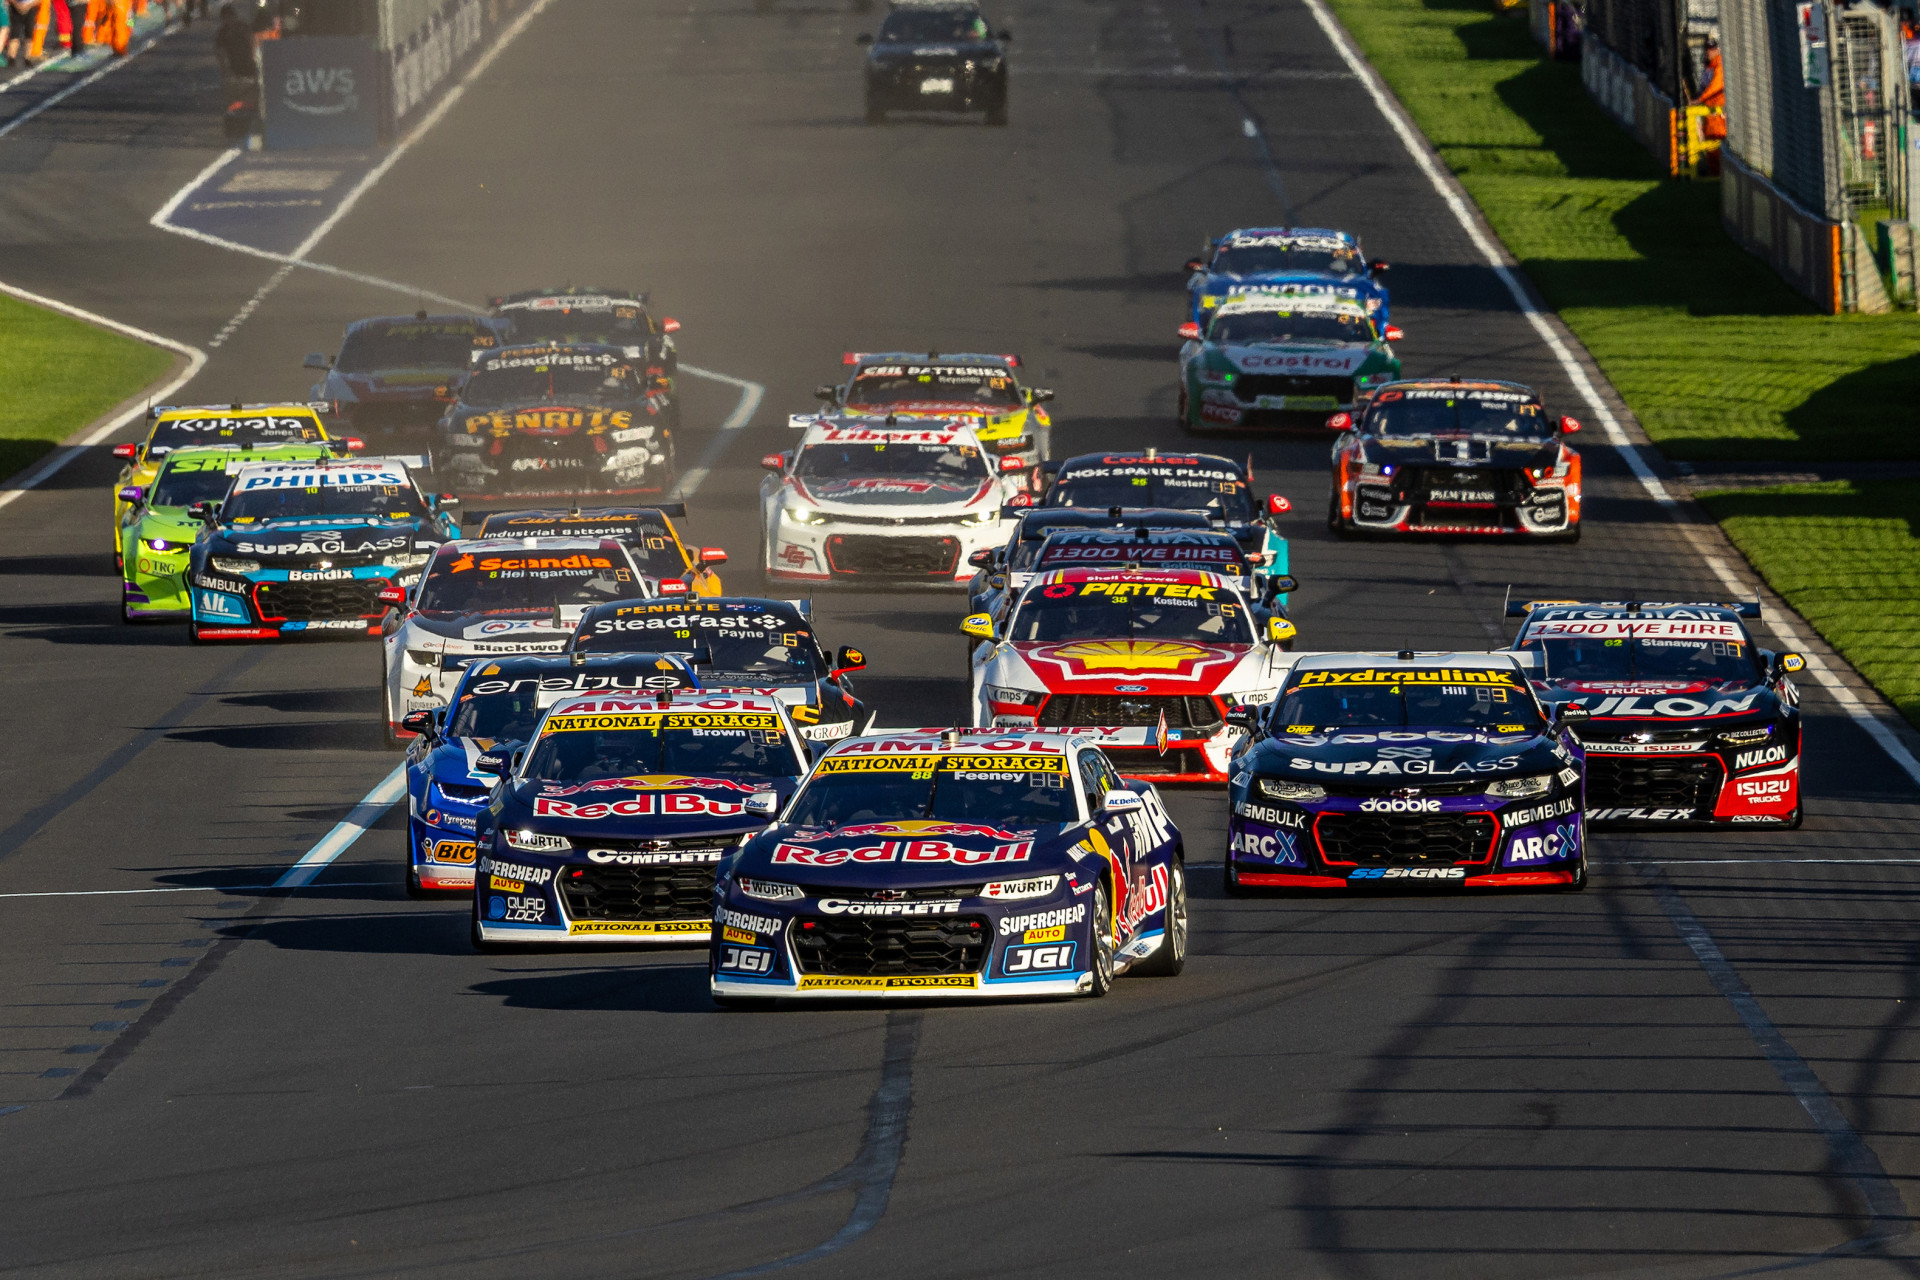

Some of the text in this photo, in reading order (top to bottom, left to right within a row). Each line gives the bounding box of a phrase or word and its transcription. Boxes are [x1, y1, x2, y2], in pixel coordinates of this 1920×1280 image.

[286, 67, 354, 95] aws
[1231, 236, 1344, 249] DAYCO
[487, 354, 593, 371] Steadfast
[1241, 355, 1351, 370] Castrol
[907, 366, 1007, 377] BATTERIES
[171, 416, 303, 433] Kubota
[466, 411, 633, 434] PENRITE
[825, 429, 955, 445] Liberty
[1102, 456, 1199, 465] Coates
[245, 472, 402, 490] PHILIPS
[1066, 467, 1237, 481] NGK SPARK PLUGS
[305, 487, 318, 495] 10
[562, 527, 633, 536] Batteries
[237, 536, 406, 555] SUPAGLASS
[1048, 548, 1233, 560] 1300 WE HIRE
[152, 560, 176, 575] TRG
[479, 555, 612, 571] Scandia
[289, 569, 354, 581] Bendix
[489, 570, 498, 579] 8
[500, 567, 594, 579] Heimgartner
[1086, 574, 1180, 583] Shell V-Power
[194, 573, 247, 595] MGMBULK
[1079, 582, 1219, 601] PIRTEK
[201, 593, 229, 613] Alt.
[1111, 596, 1128, 604] 38
[1153, 596, 1198, 608] Kostecki
[616, 603, 721, 616] PENRITE
[1542, 609, 1723, 621] PremiAir
[594, 613, 751, 635] Steadfast
[1530, 623, 1735, 637] 1300 WE HIRE
[674, 629, 690, 639] 19
[718, 628, 765, 640] Payne
[1604, 638, 1623, 648] 62
[1641, 638, 1709, 650] Stanaway
[1786, 656, 1801, 669] NAPA
[472, 673, 681, 696] erebus
[1299, 669, 1514, 685] Hydraulink
[999, 690, 1022, 702] mps
[1248, 691, 1268, 702] mps
[1389, 685, 1401, 695] 4
[1441, 686, 1468, 696] Hill
[557, 699, 772, 714] AMPOL
[1554, 694, 1760, 717] ULON
[548, 714, 773, 730] NATIONAL STORAGE
[650, 729, 658, 738] 1
[692, 728, 746, 737] Brown
[813, 723, 849, 739] GROVE
[836, 740, 1061, 755] AMPOL
[1643, 744, 1693, 752] ISUZU
[1735, 744, 1786, 769] NULON
[820, 756, 1058, 773] NATIONAL STORAGE
[1288, 755, 1519, 776] SUPAGLASS
[910, 771, 932, 781] 88
[953, 770, 1025, 783] Feeney
[1519, 777, 1542, 788] Rock
[1737, 779, 1790, 796] ISUZU
[534, 793, 749, 819] Red Bu
[1358, 797, 1443, 813] dabble
[1748, 795, 1782, 804] TRUCKS
[1235, 799, 1306, 829] MGMBULK
[1502, 796, 1576, 829] MGMBULK
[587, 849, 722, 865] COMPLETE
[771, 840, 1035, 867] Red Bull
[478, 855, 552, 886] SUPERCHEAP
[493, 878, 521, 891] AUTO
[752, 880, 795, 898] WÜRTH
[1003, 878, 1054, 895] WÜRTH
[507, 896, 546, 911] QUAD
[817, 898, 962, 916] COMPLETE
[505, 909, 545, 923] LOCK
[714, 904, 783, 937] SUPERCHEAP
[999, 902, 1087, 937] SUPERCHEAP
[572, 922, 712, 933] NATIONAL STORA
[725, 928, 754, 942] AUTO
[1028, 928, 1061, 941] AUTO
[721, 947, 772, 972] JGI
[1009, 945, 1072, 972] JGI
[801, 976, 972, 988] NATIONAL STORAGE
